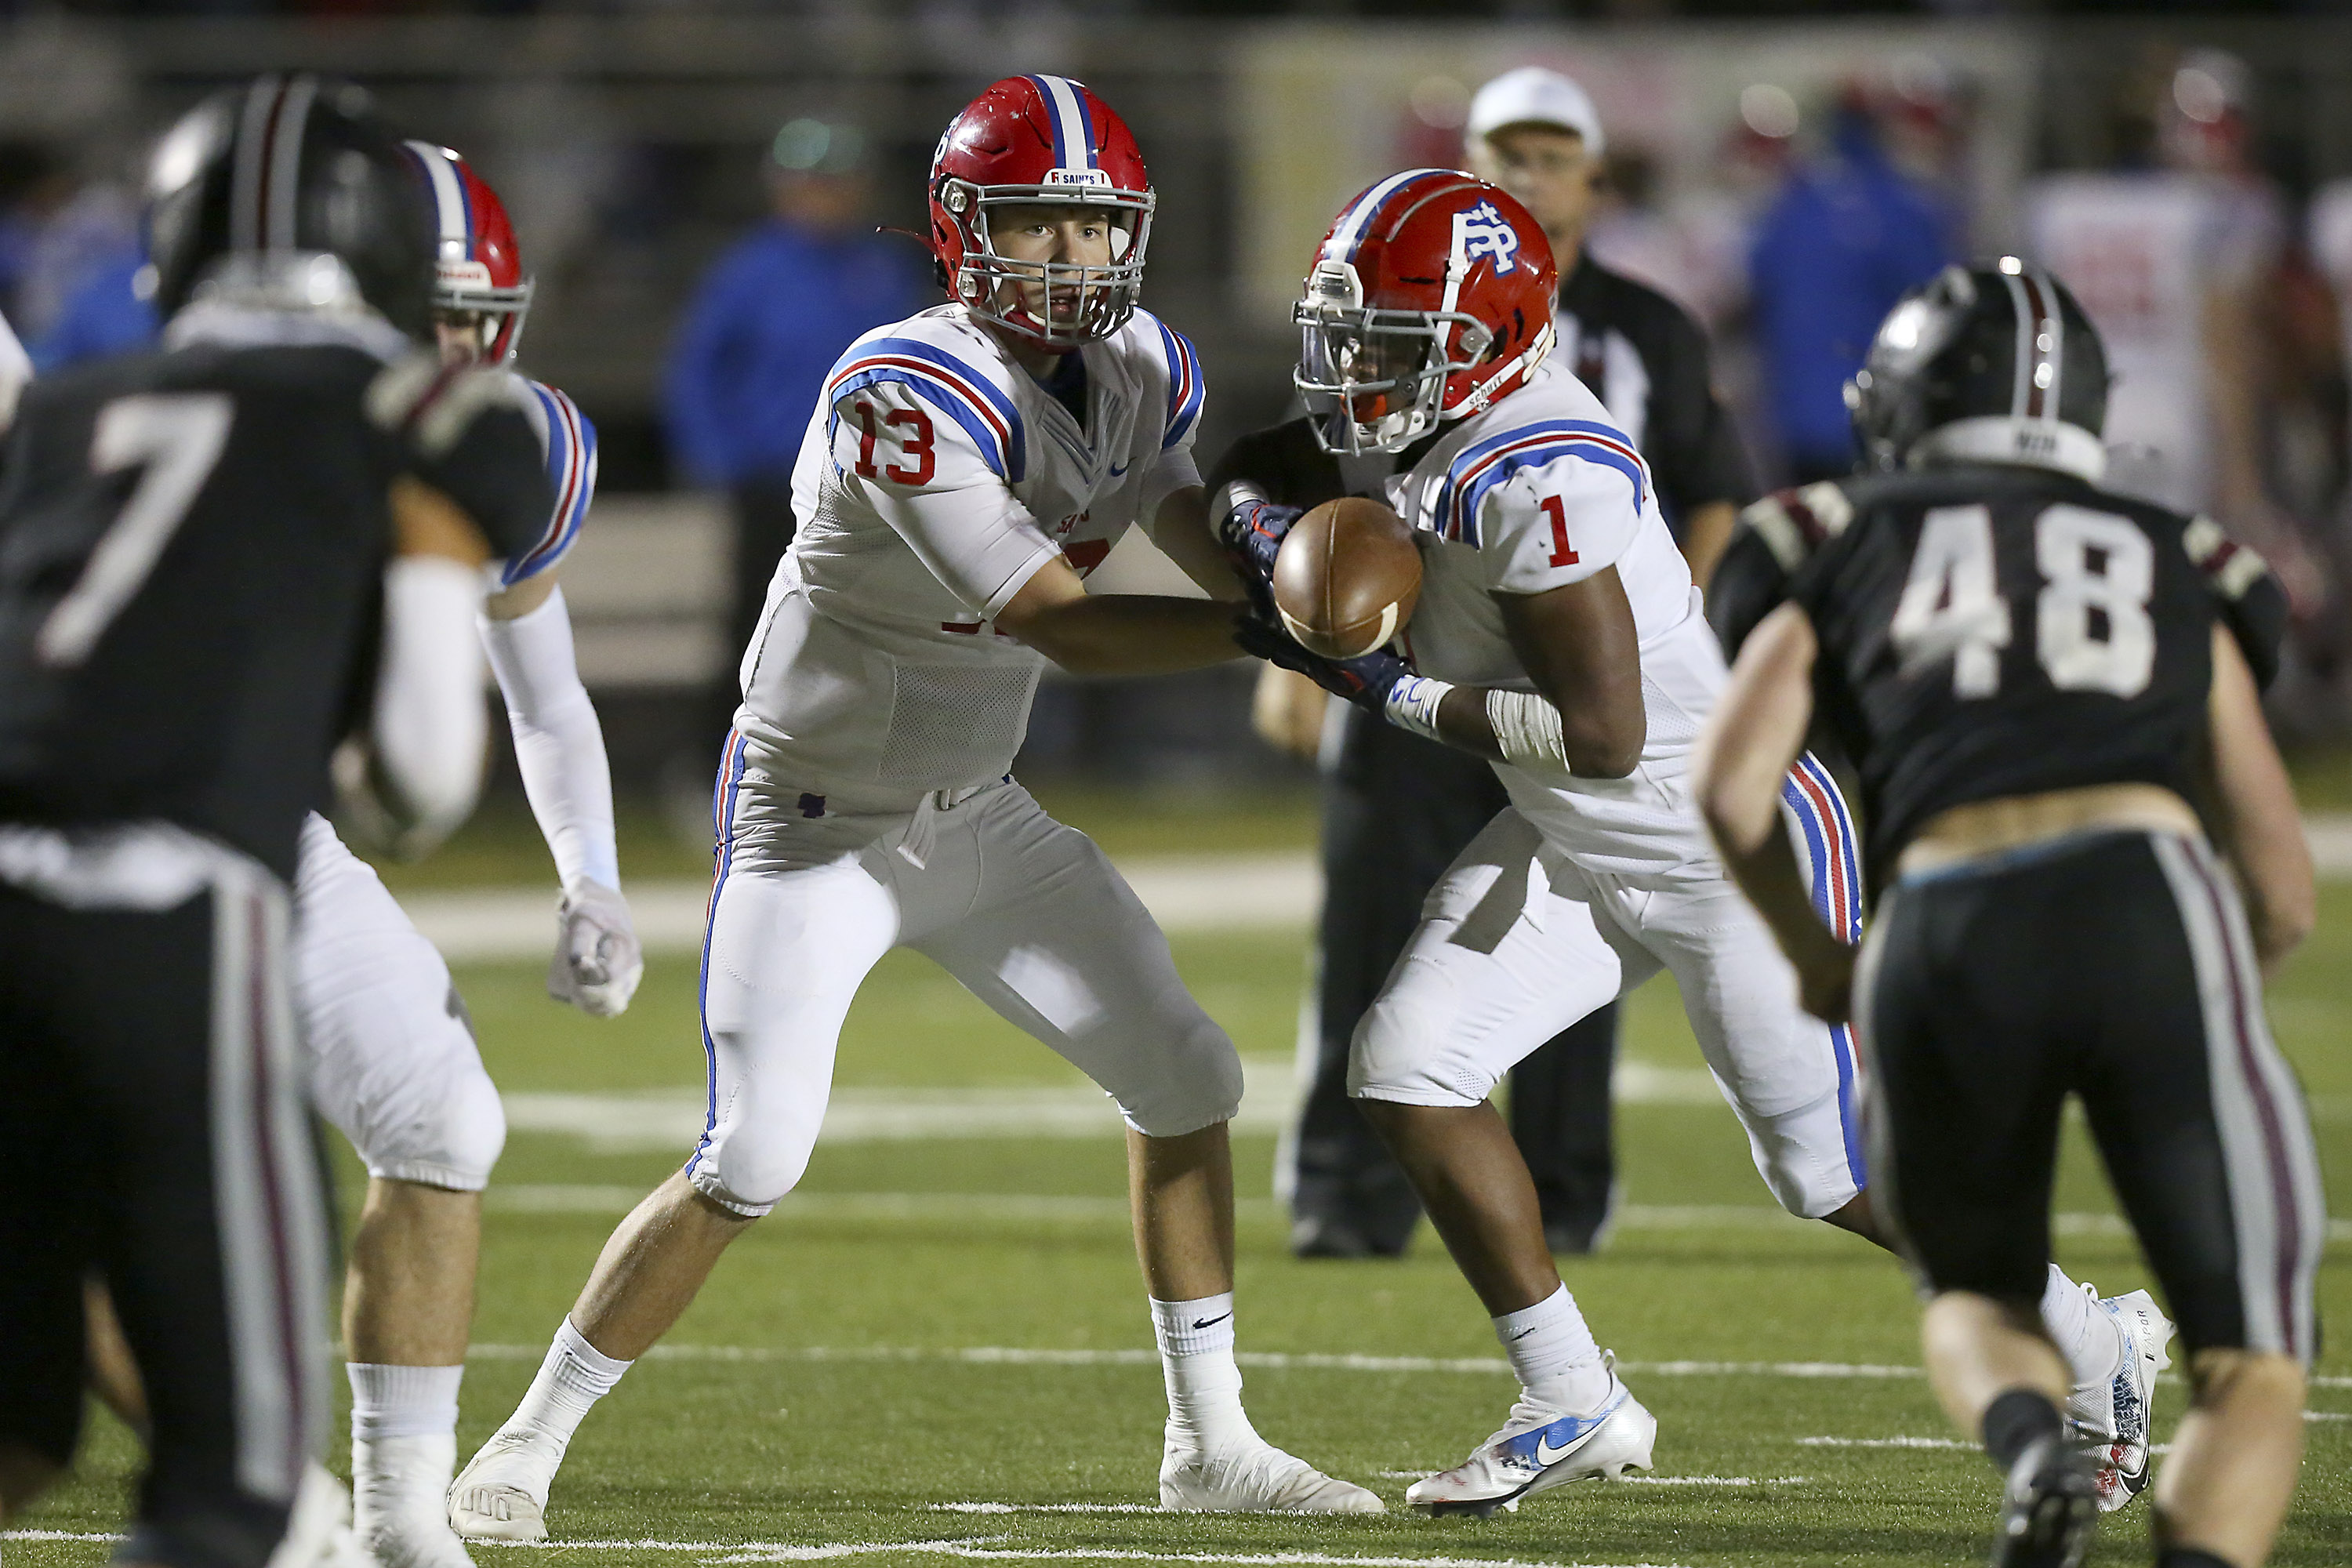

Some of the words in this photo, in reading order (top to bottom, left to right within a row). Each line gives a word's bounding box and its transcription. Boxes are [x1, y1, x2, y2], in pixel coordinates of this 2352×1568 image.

[1063, 174, 1095, 185] SAINTS
[855, 401, 935, 486] 13
[34, 393, 235, 668] 7
[1540, 494, 1580, 568] 1
[1888, 503, 2157, 700] 48
